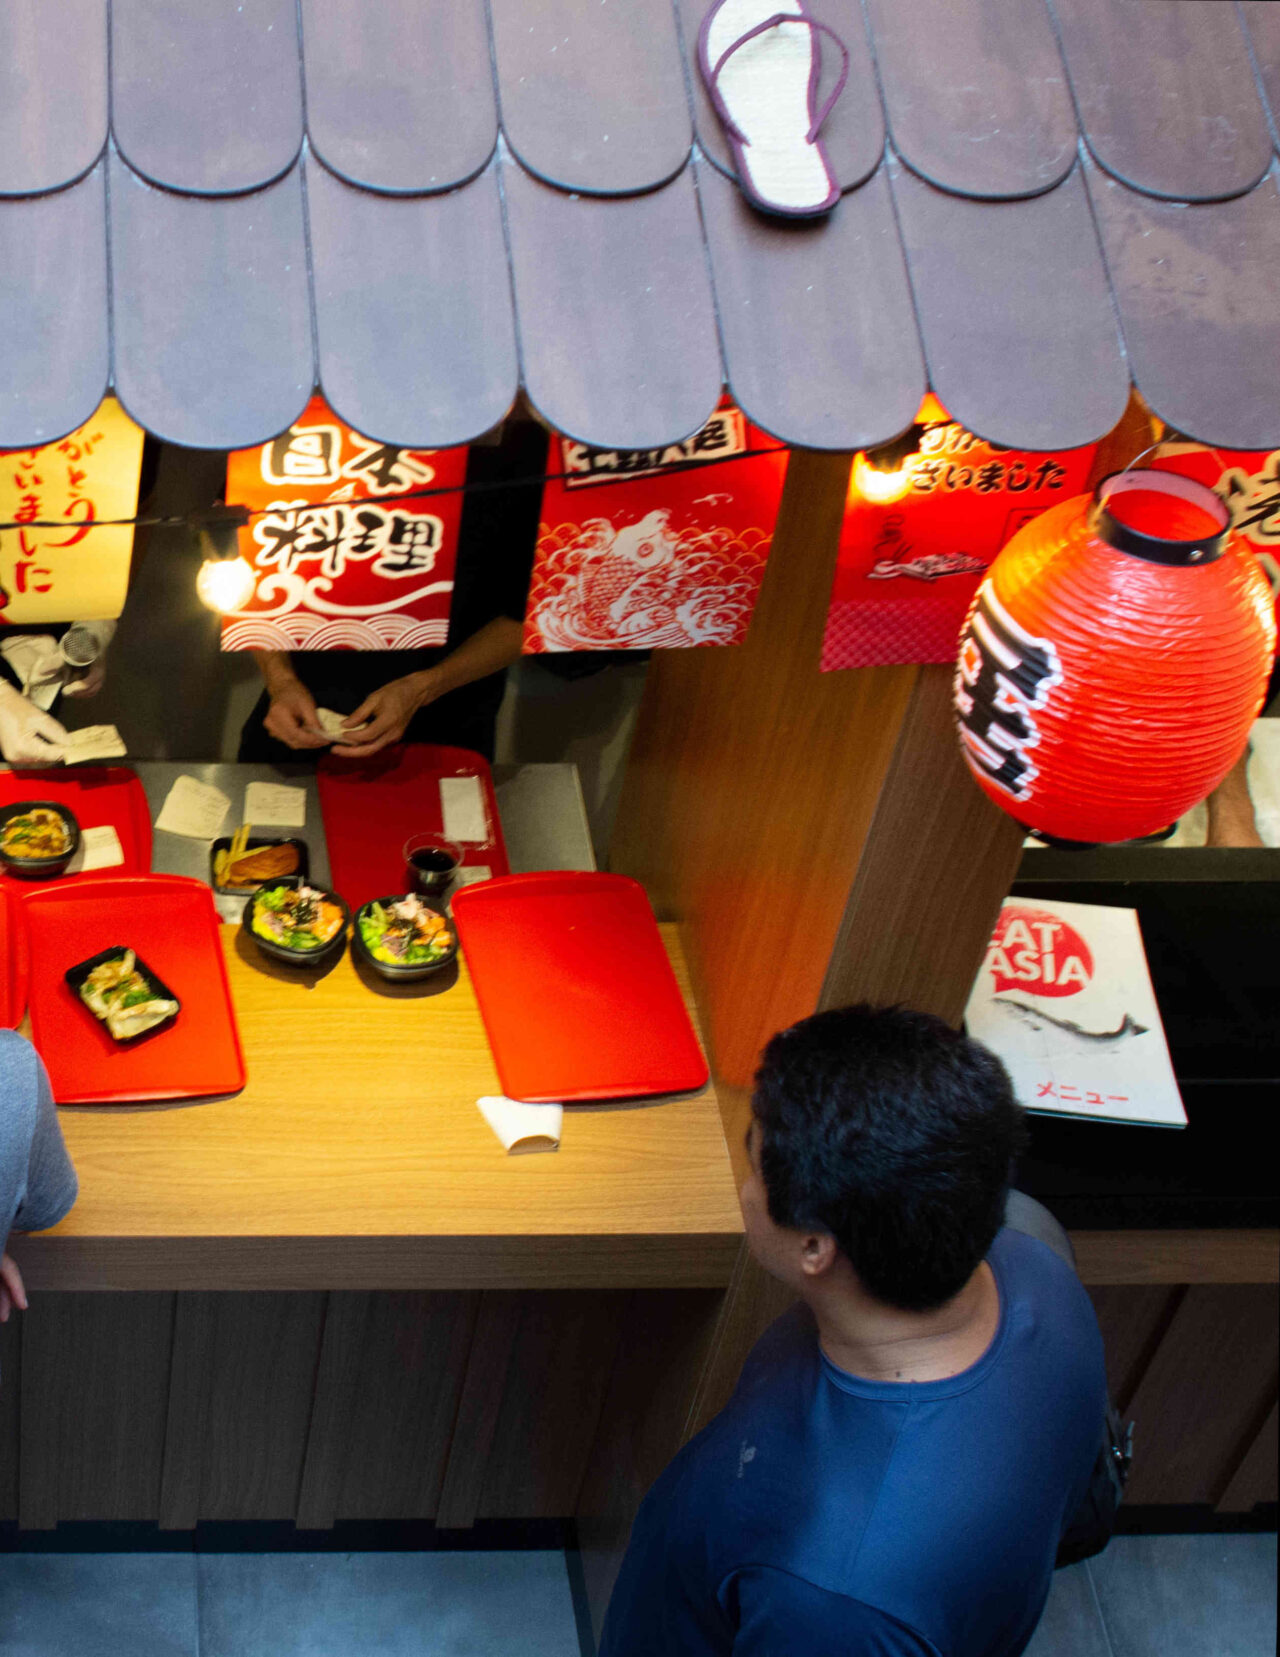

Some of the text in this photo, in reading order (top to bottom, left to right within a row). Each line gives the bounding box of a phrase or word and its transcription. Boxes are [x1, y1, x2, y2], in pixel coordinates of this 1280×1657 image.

[988, 947, 1091, 988] ASIA
[1036, 1081, 1129, 1105] メニュー
